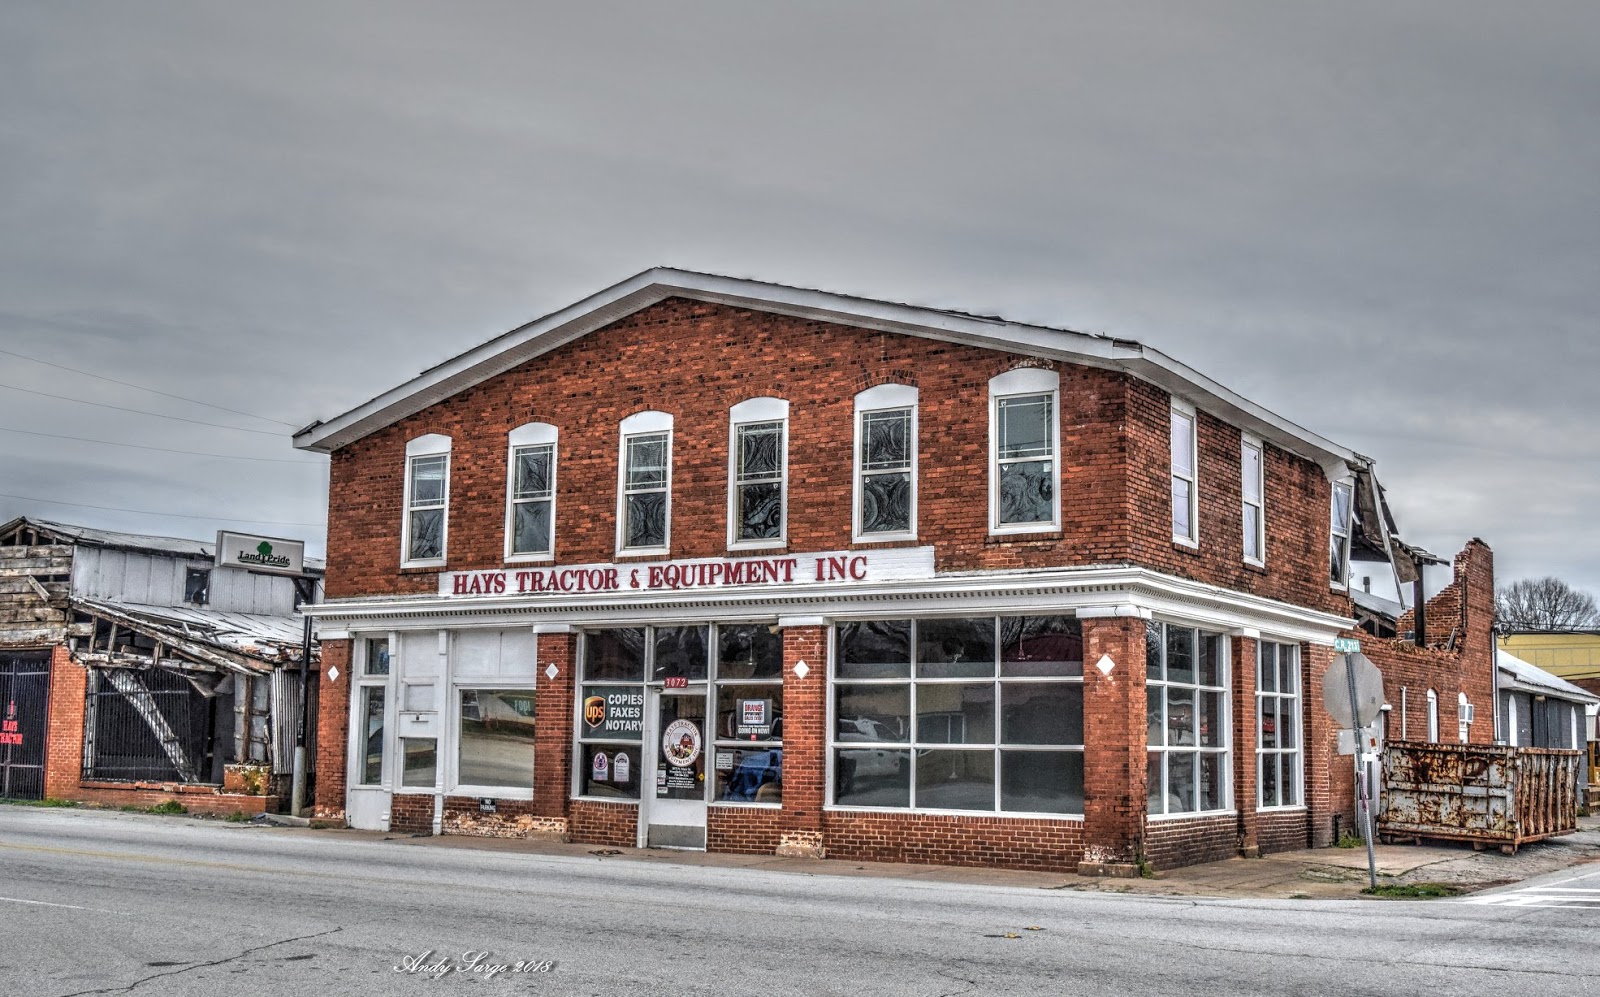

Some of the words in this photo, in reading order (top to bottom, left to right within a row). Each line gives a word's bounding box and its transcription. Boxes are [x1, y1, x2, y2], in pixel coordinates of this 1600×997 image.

[238, 551, 261, 560] Land
[267, 554, 290, 565] Pride
[453, 573, 507, 595] HAYS
[515, 569, 619, 592] TRACTOR
[630, 569, 640, 588] &
[647, 559, 797, 590] EQUIPMENT
[815, 556, 867, 581] INC
[665, 678, 686, 687] 3072
[608, 694, 643, 705] COPIES
[610, 707, 640, 718] FAXES
[605, 720, 643, 731] NOTARY
